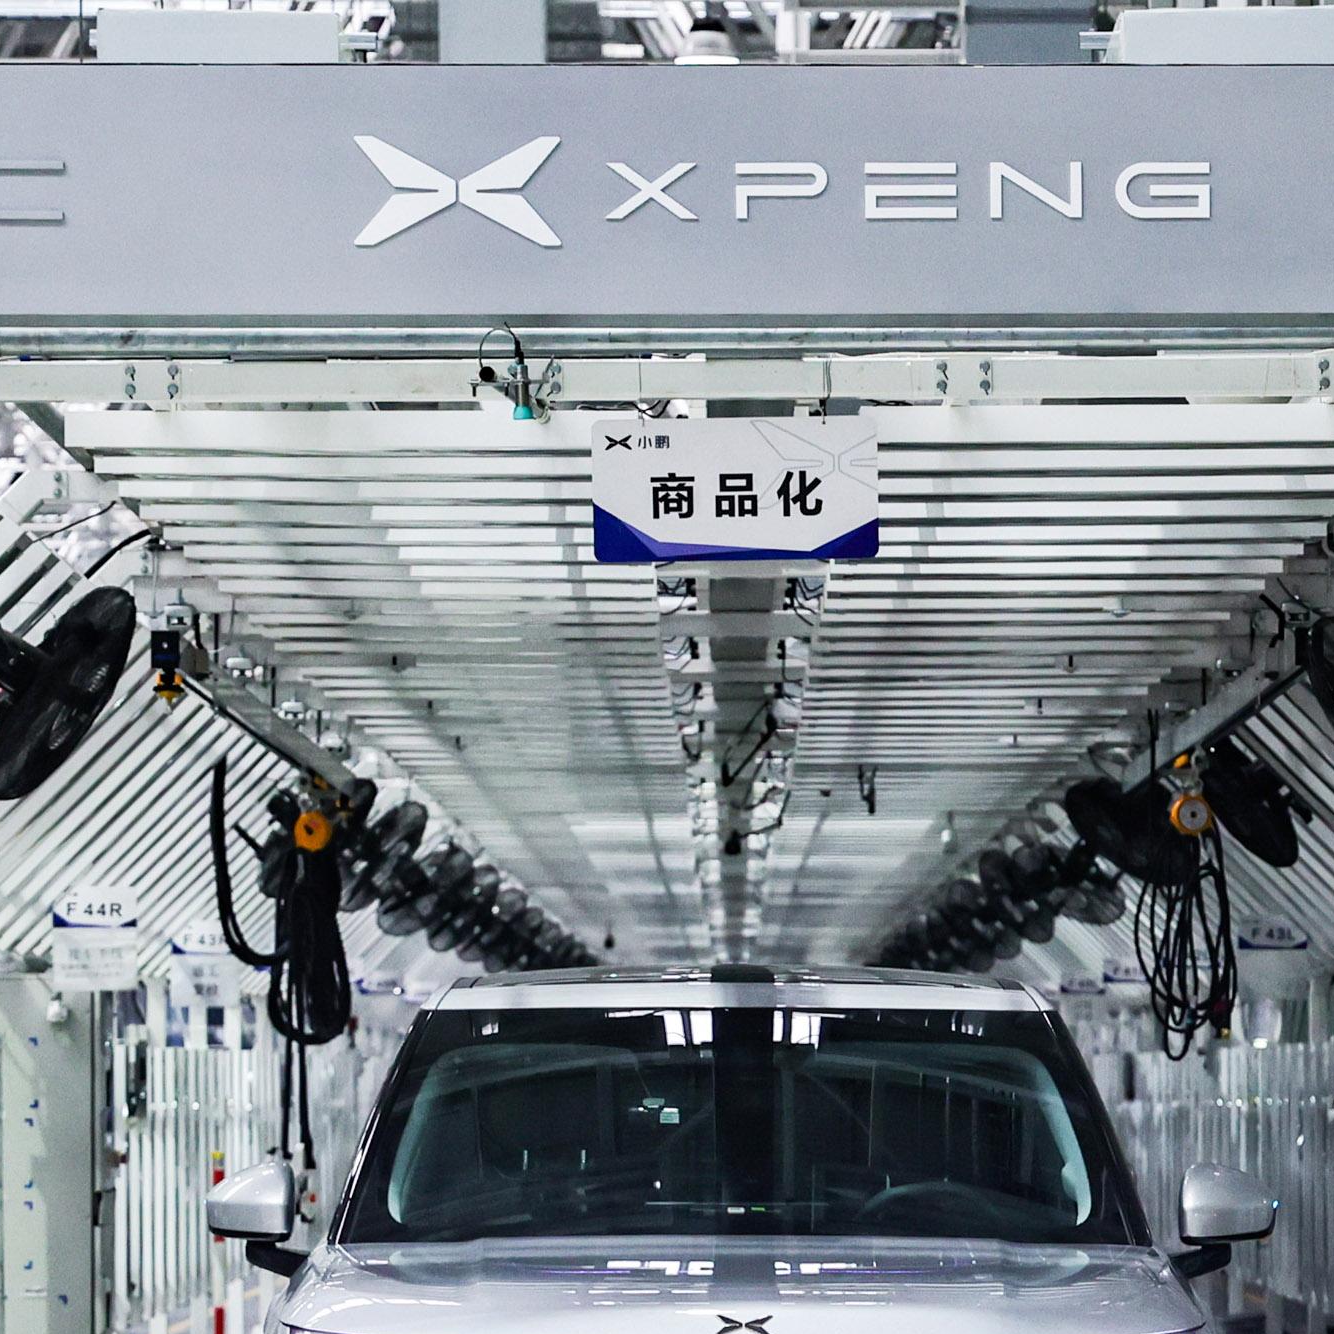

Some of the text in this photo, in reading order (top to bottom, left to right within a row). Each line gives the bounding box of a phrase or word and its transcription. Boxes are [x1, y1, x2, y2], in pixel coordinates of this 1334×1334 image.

[605, 161, 1211, 220] XPENG
[638, 435, 670, 449] 小鹏
[650, 471, 823, 519] 商品化
[67, 903, 122, 917] F 44R
